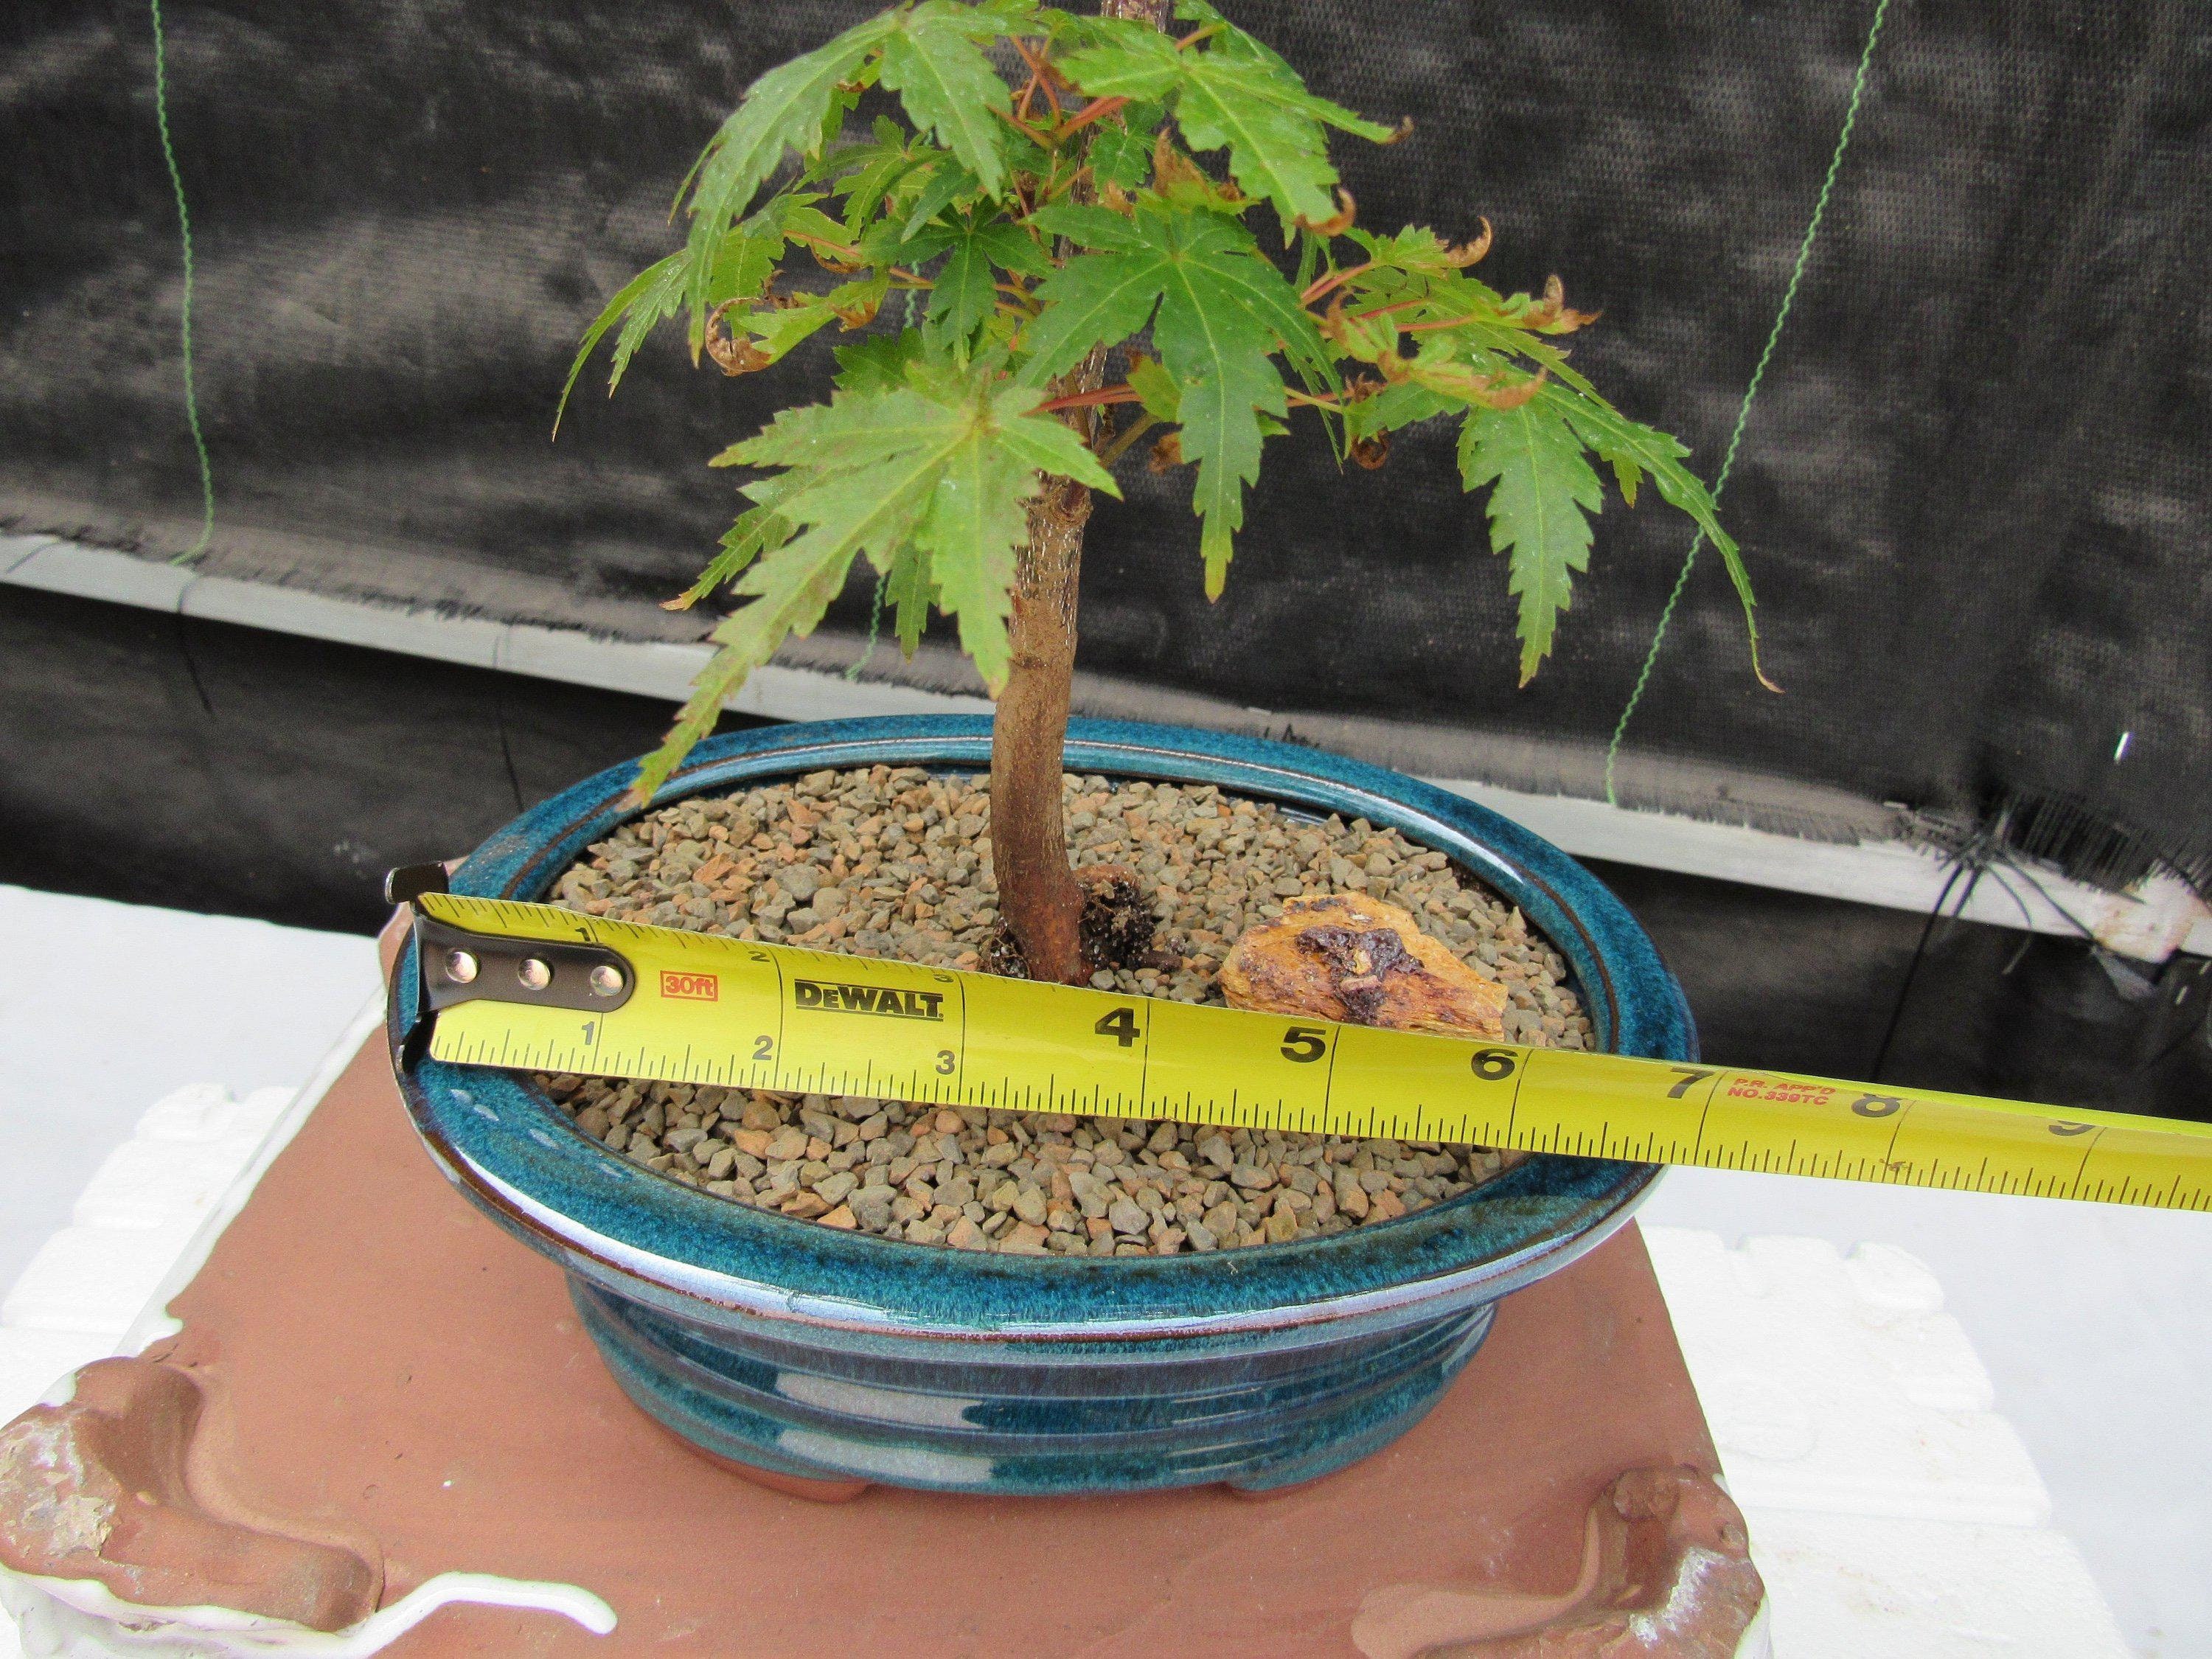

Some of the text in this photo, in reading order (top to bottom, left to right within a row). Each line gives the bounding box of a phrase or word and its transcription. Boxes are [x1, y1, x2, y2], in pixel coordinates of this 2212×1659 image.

[575, 927, 591, 942] 1
[748, 950, 771, 962] 2
[666, 975, 714, 998] 30ft
[582, 1021, 595, 1046] 1
[1094, 1007, 1140, 1047] 4
[753, 1035, 773, 1060] 2
[1280, 1026, 1326, 1062] 5
[936, 1050, 956, 1075] 3
[1471, 1048, 1518, 1081] 6
[1667, 1068, 1716, 1099] 7
